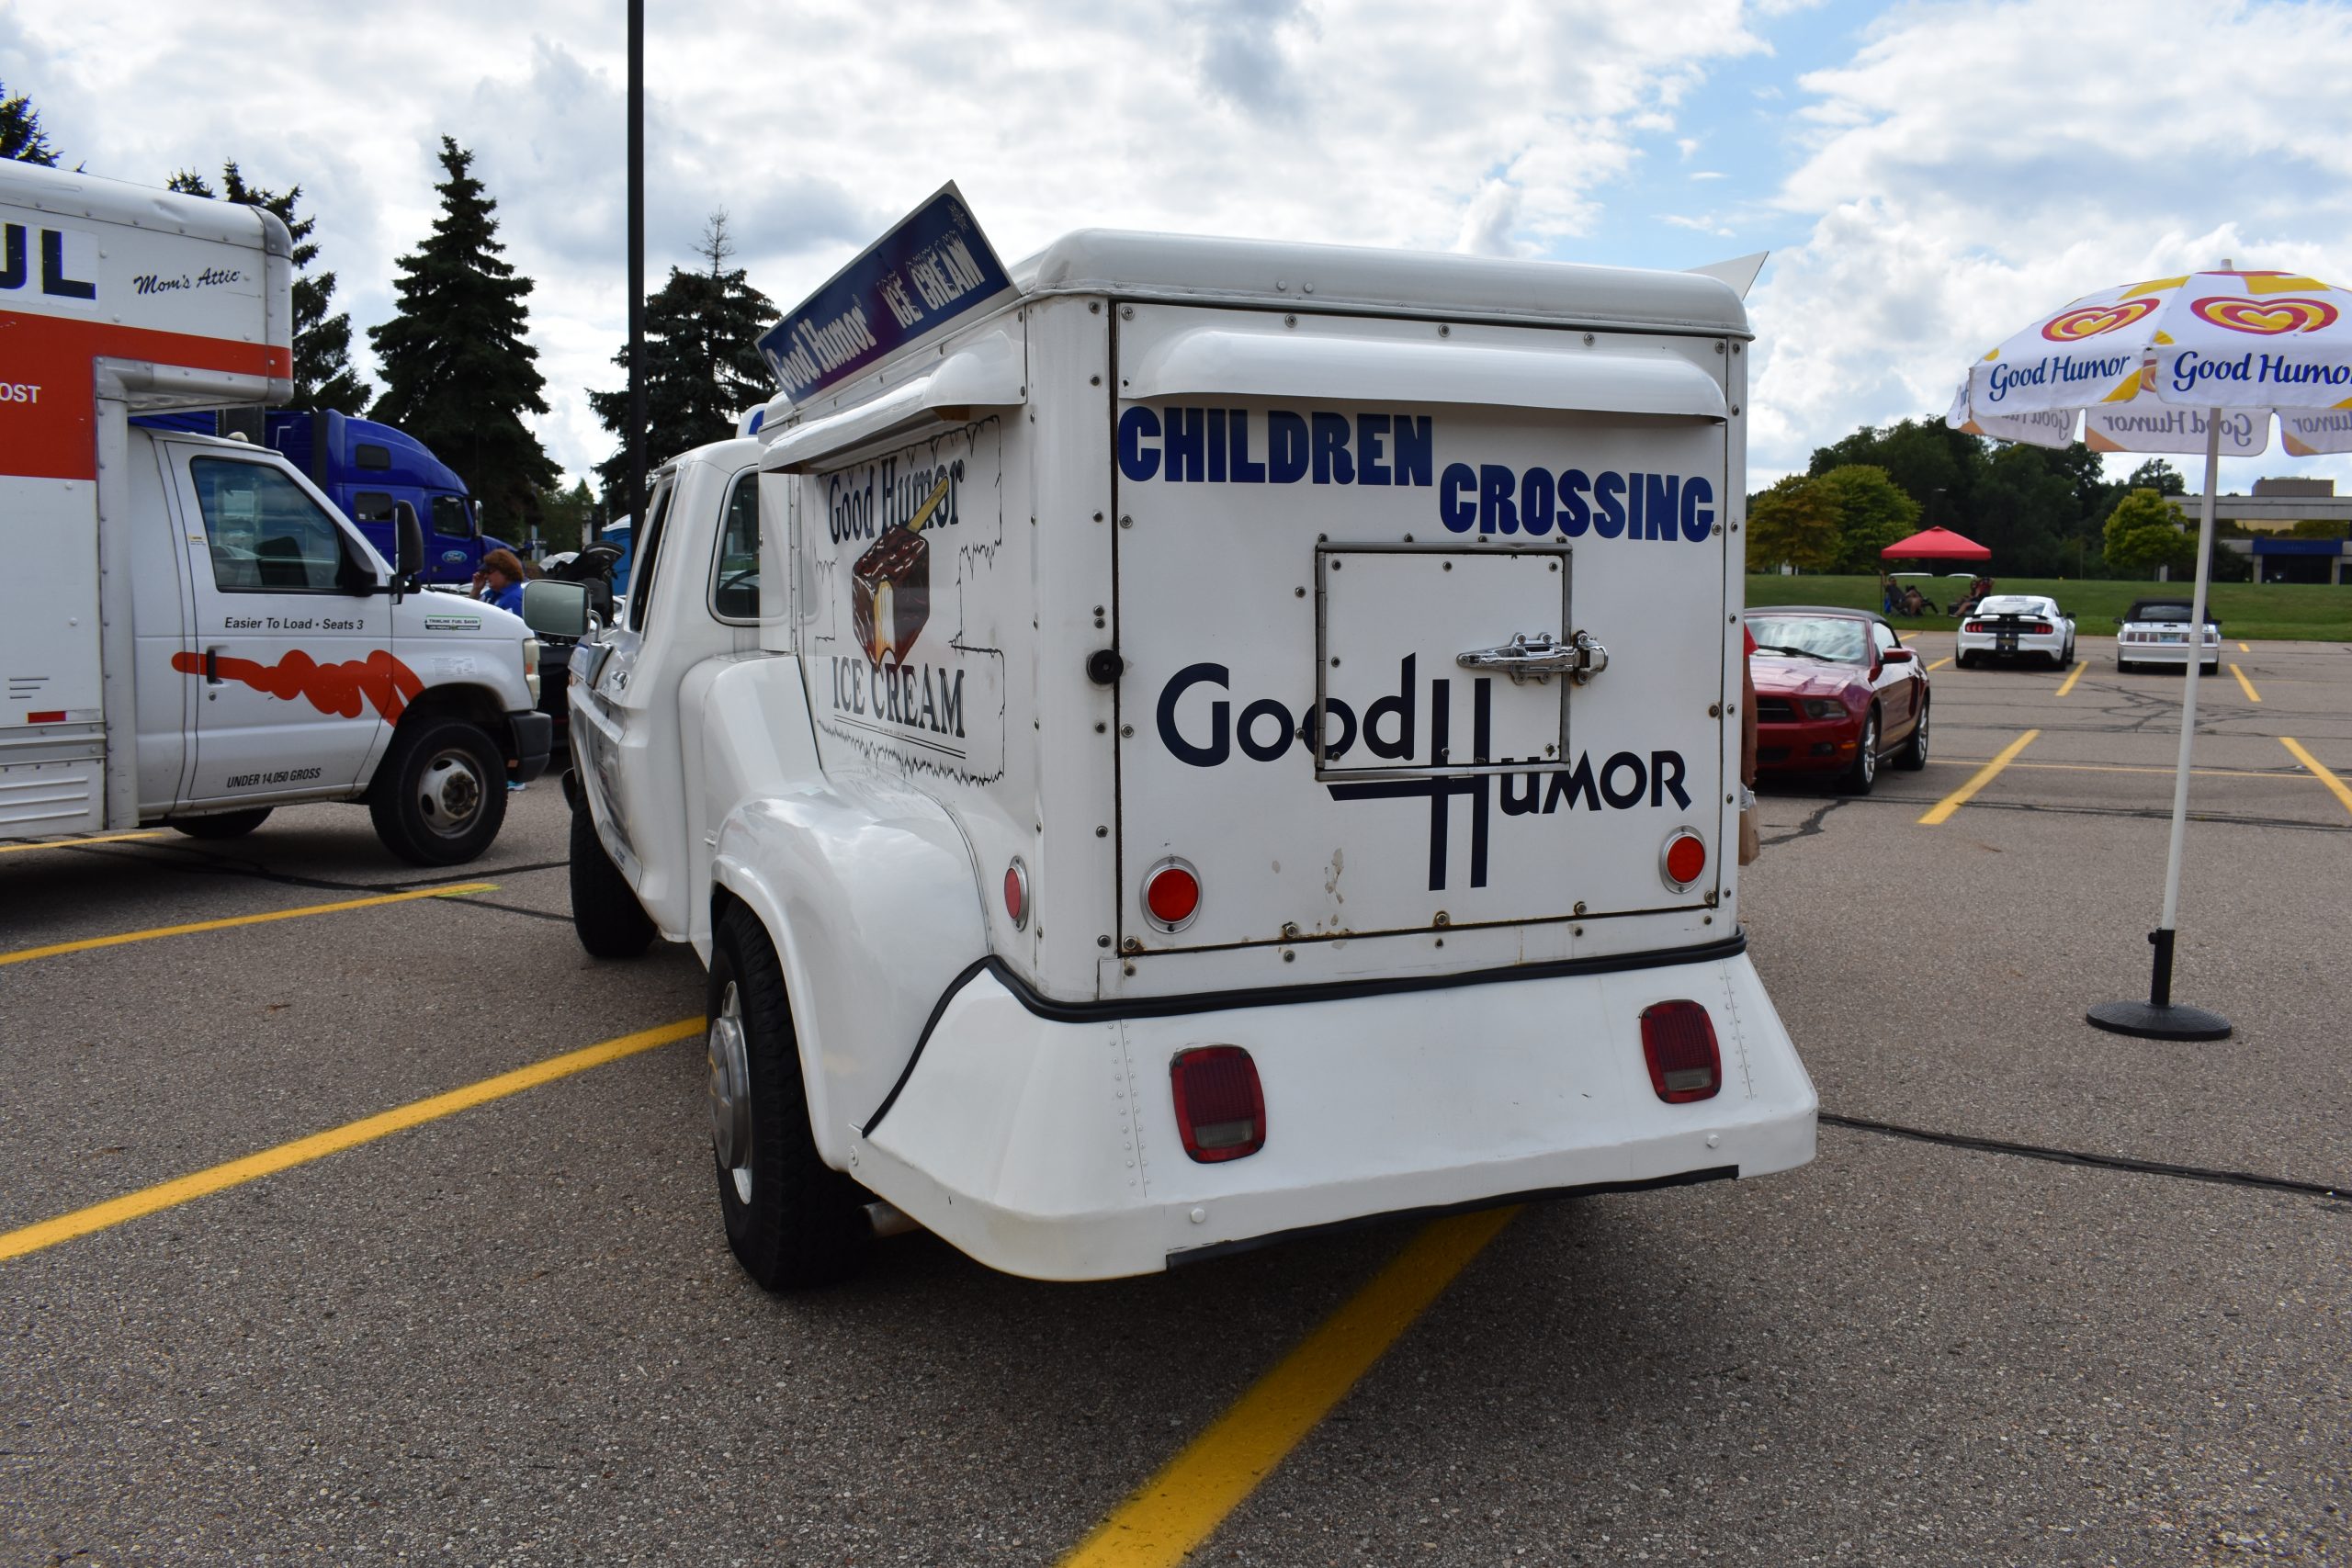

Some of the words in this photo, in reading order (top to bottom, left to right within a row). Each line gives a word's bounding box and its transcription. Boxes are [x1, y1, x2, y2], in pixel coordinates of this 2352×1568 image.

[133, 275, 190, 295] Mom's
[196, 267, 240, 288] Attic
[766, 332, 820, 393] Good
[798, 305, 877, 372] Humor
[876, 271, 923, 328] ICE
[906, 230, 986, 310] CREAM
[1988, 357, 2045, 402] Good
[2051, 355, 2131, 383] Humor
[2172, 351, 2253, 391] Good
[2259, 354, 2352, 385] Humo
[830, 465, 876, 545] Good
[881, 456, 965, 536] Humor
[1116, 405, 1433, 486] CHILDREN
[1439, 463, 1715, 542] CROSSING
[224, 616, 263, 629] Easier
[266, 617, 280, 629] To
[283, 617, 312, 629] Load
[322, 618, 354, 630] Seats
[356, 619, 364, 630] 3
[831, 656, 865, 716] ICE
[870, 662, 966, 739] CREAM
[1156, 652, 1417, 768] Good
[227, 773, 260, 788] UNDER
[289, 767, 322, 781] GROSS
